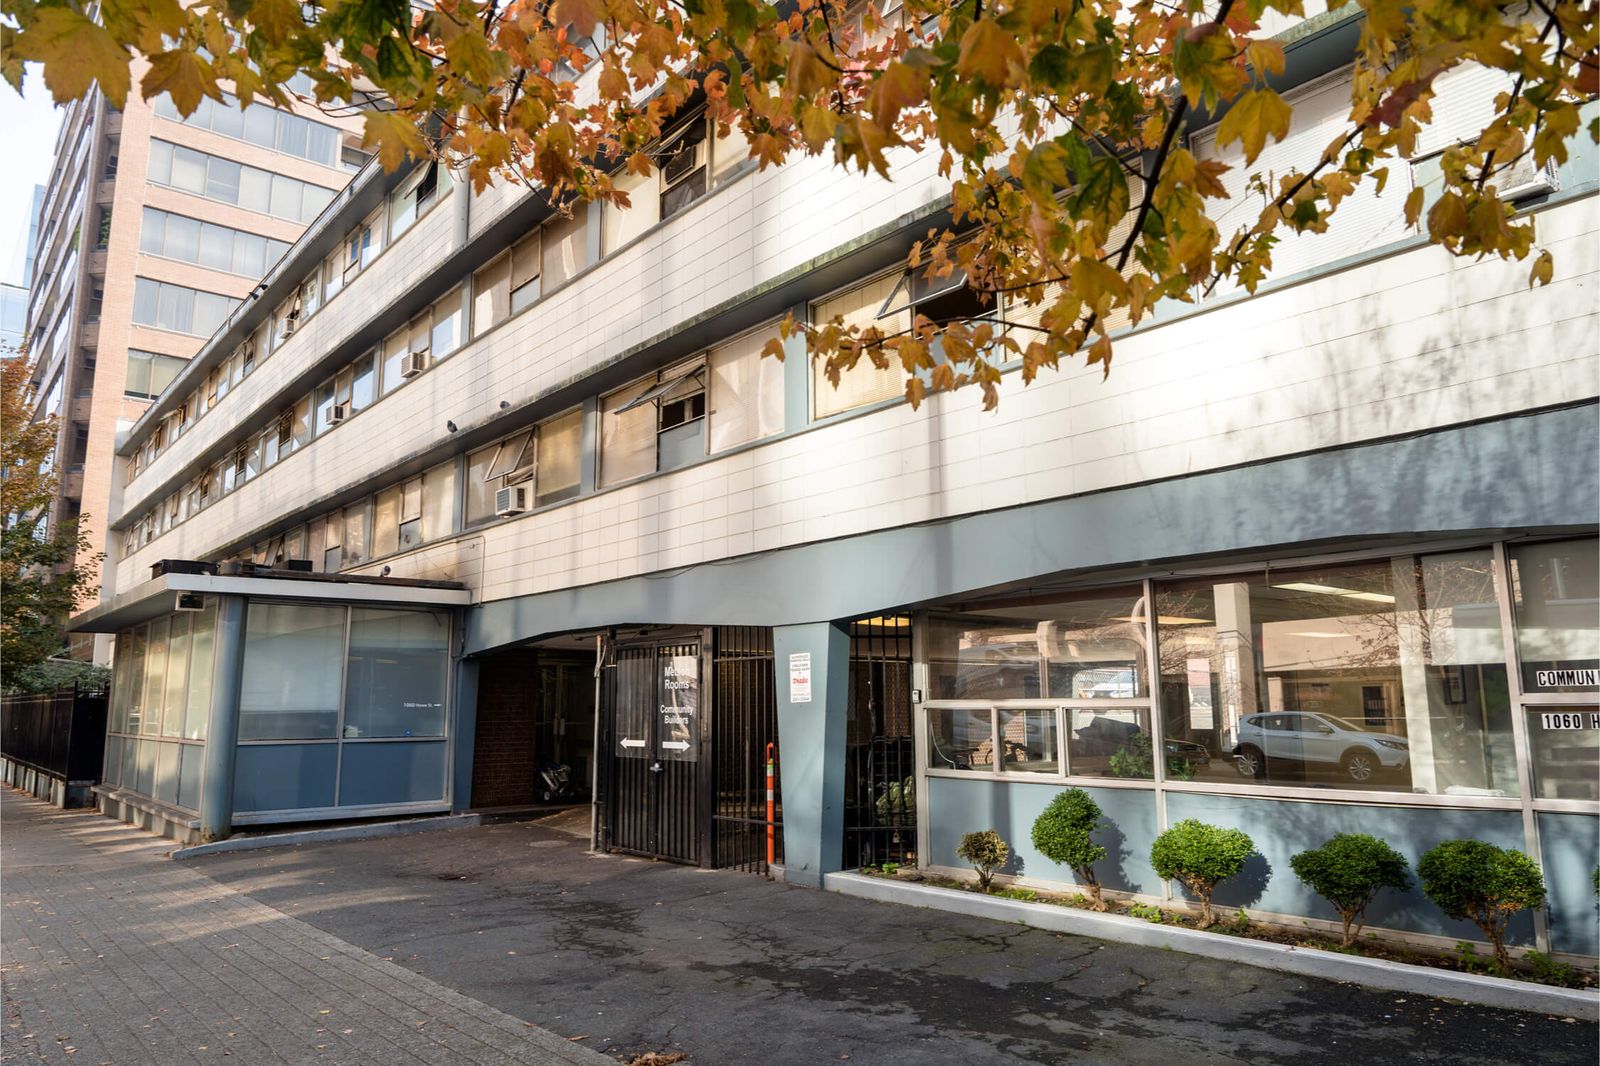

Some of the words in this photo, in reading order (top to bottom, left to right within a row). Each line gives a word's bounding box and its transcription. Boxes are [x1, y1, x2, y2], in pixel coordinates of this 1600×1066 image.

[664, 679, 690, 690] Rooms
[660, 704, 693, 716] Community
[664, 715, 689, 725] Builders
[1544, 714, 1581, 729] 1060
